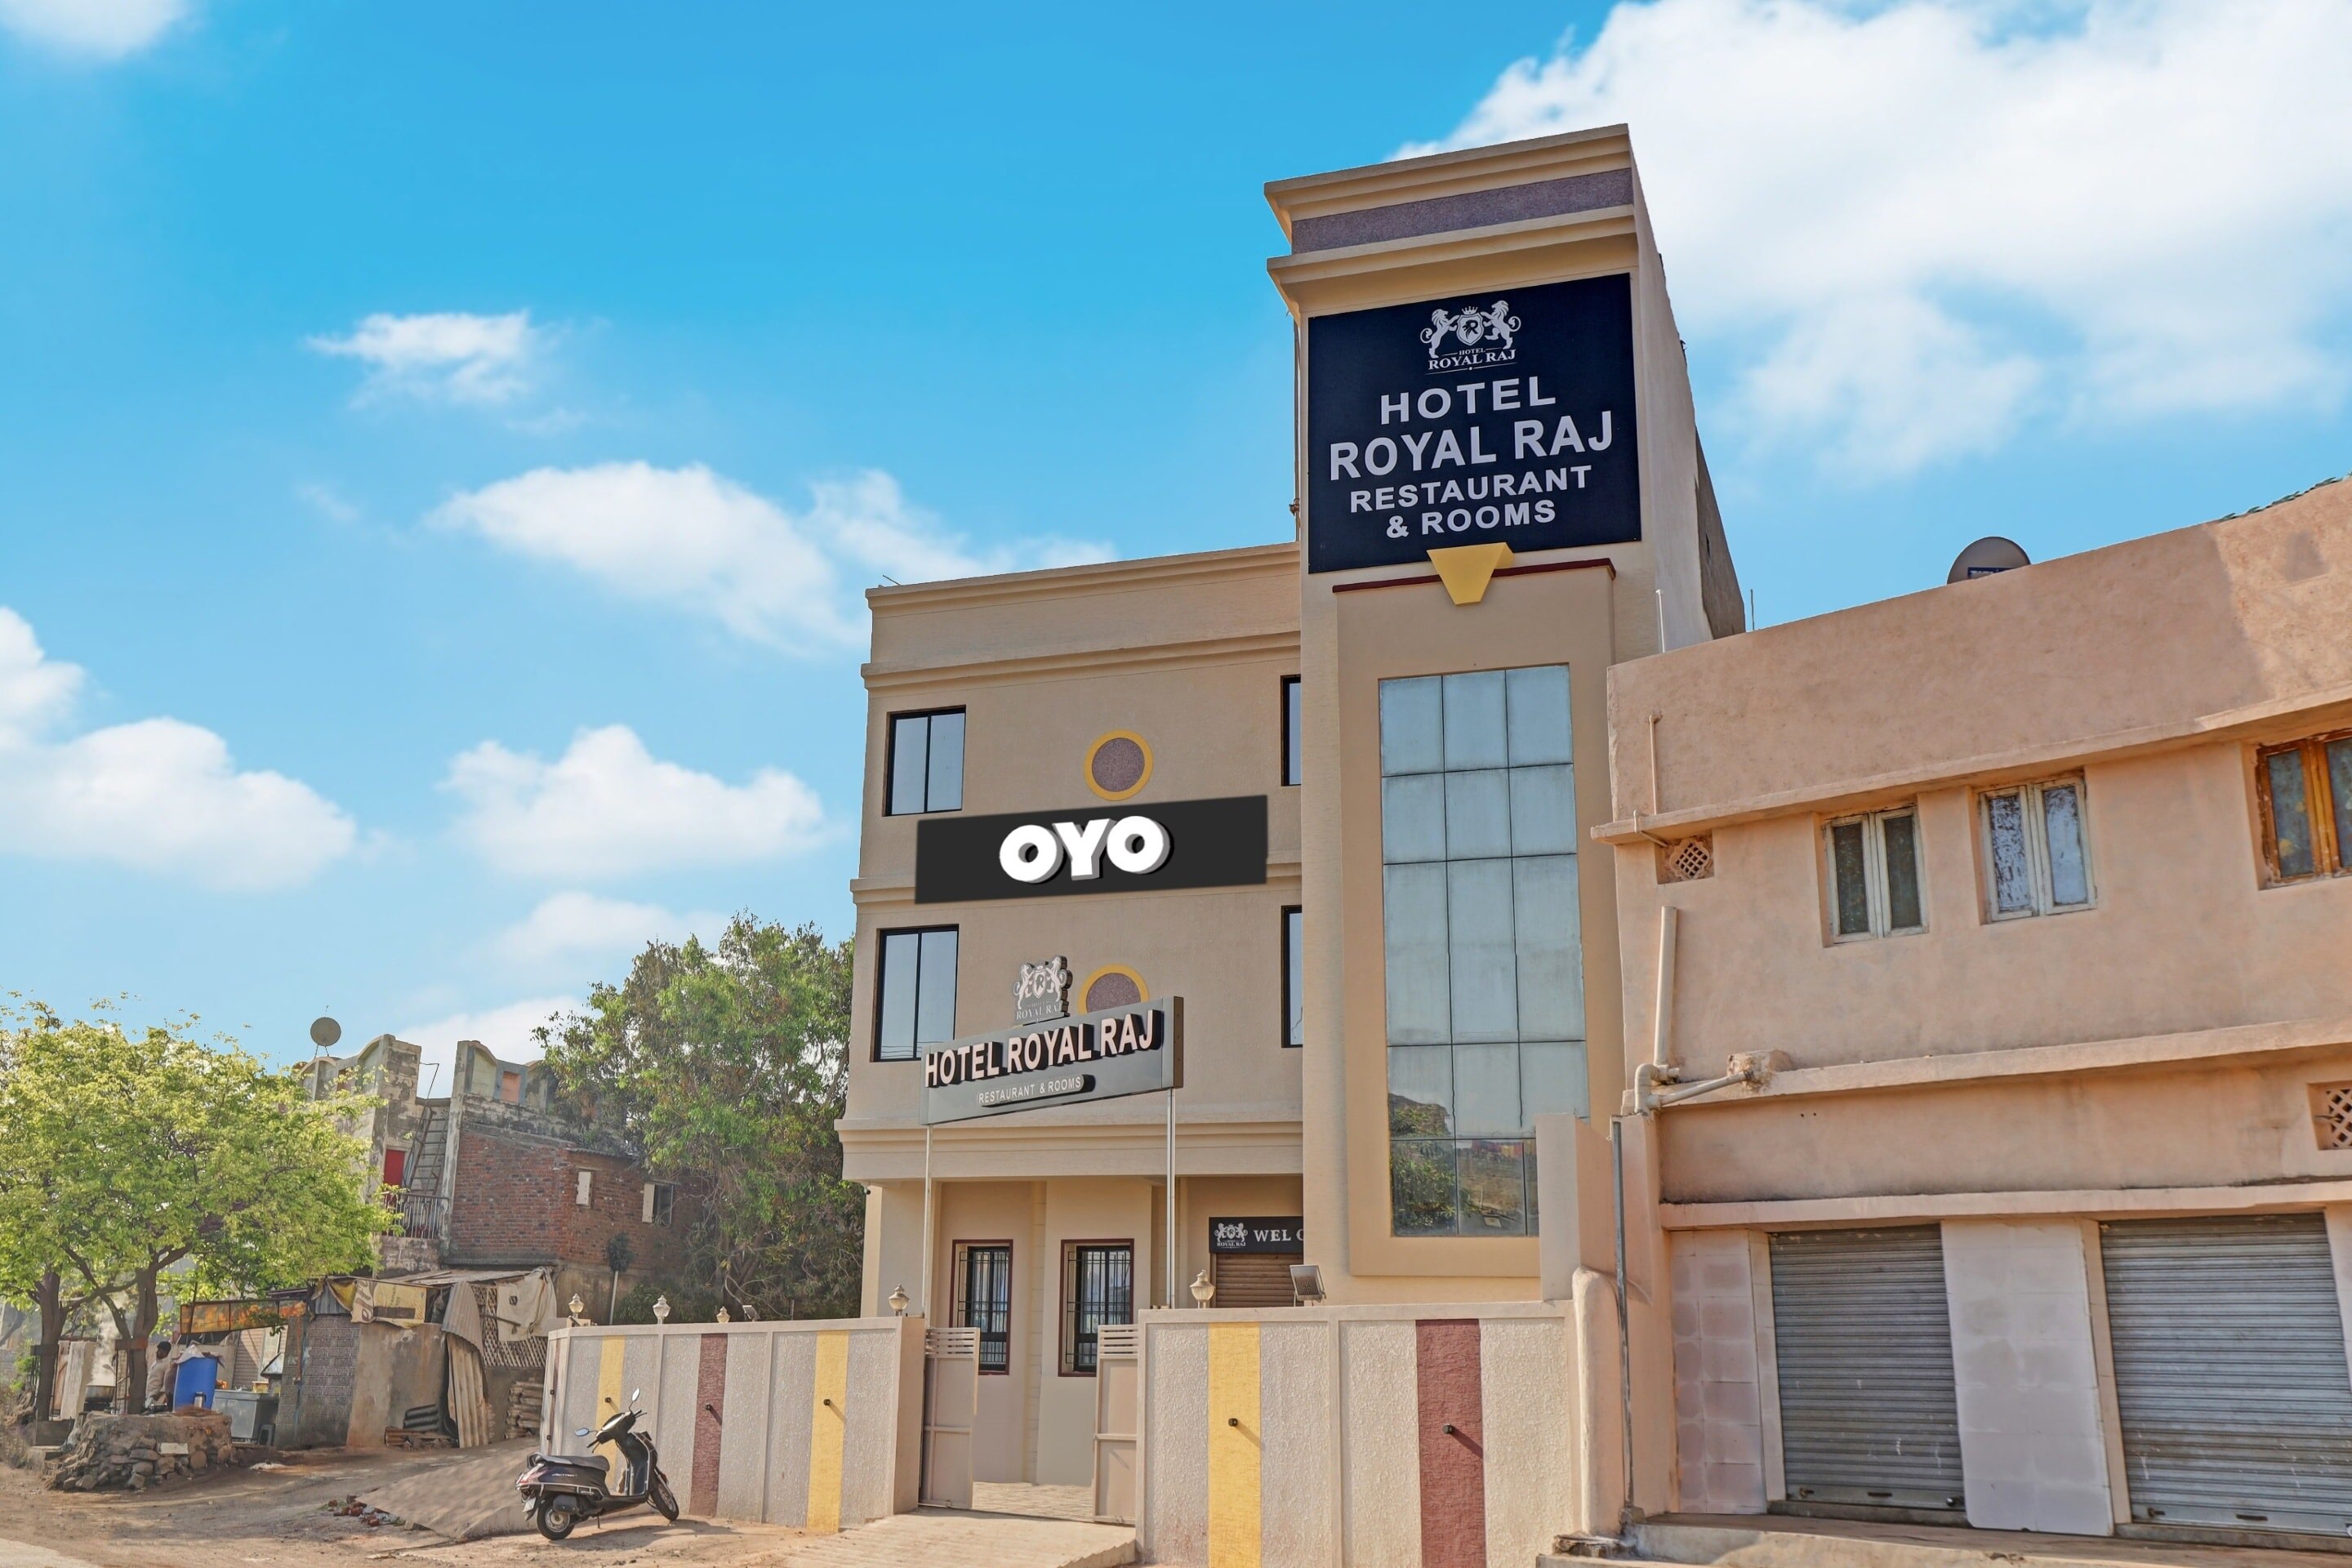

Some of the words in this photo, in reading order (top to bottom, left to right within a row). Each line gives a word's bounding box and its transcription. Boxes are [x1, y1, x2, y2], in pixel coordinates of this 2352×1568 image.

[1428, 353, 1483, 370] ROYAL
[1485, 349, 1517, 363] RAJ
[1459, 347, 1486, 356] HOTEL
[1380, 376, 1556, 425] HOTEL
[1330, 425, 1497, 481] ROYAL
[1513, 410, 1613, 461] RAJ
[1350, 465, 1592, 513] RESTAURANT
[1386, 515, 1410, 539] &
[1421, 499, 1557, 536] ROOMS
[999, 815, 1174, 884] OYO
[1016, 1005, 1044, 1020] ROYAL
[924, 1041, 1000, 1088] HOTEL
[1007, 1023, 1093, 1074] ROYAL
[1100, 1009, 1158, 1057] RAJ
[978, 1084, 1035, 1104] RESTAURANT
[1040, 1082, 1046, 1094] &
[1048, 1076, 1081, 1093] ROOMS
[1253, 1229, 1292, 1242] WEL
